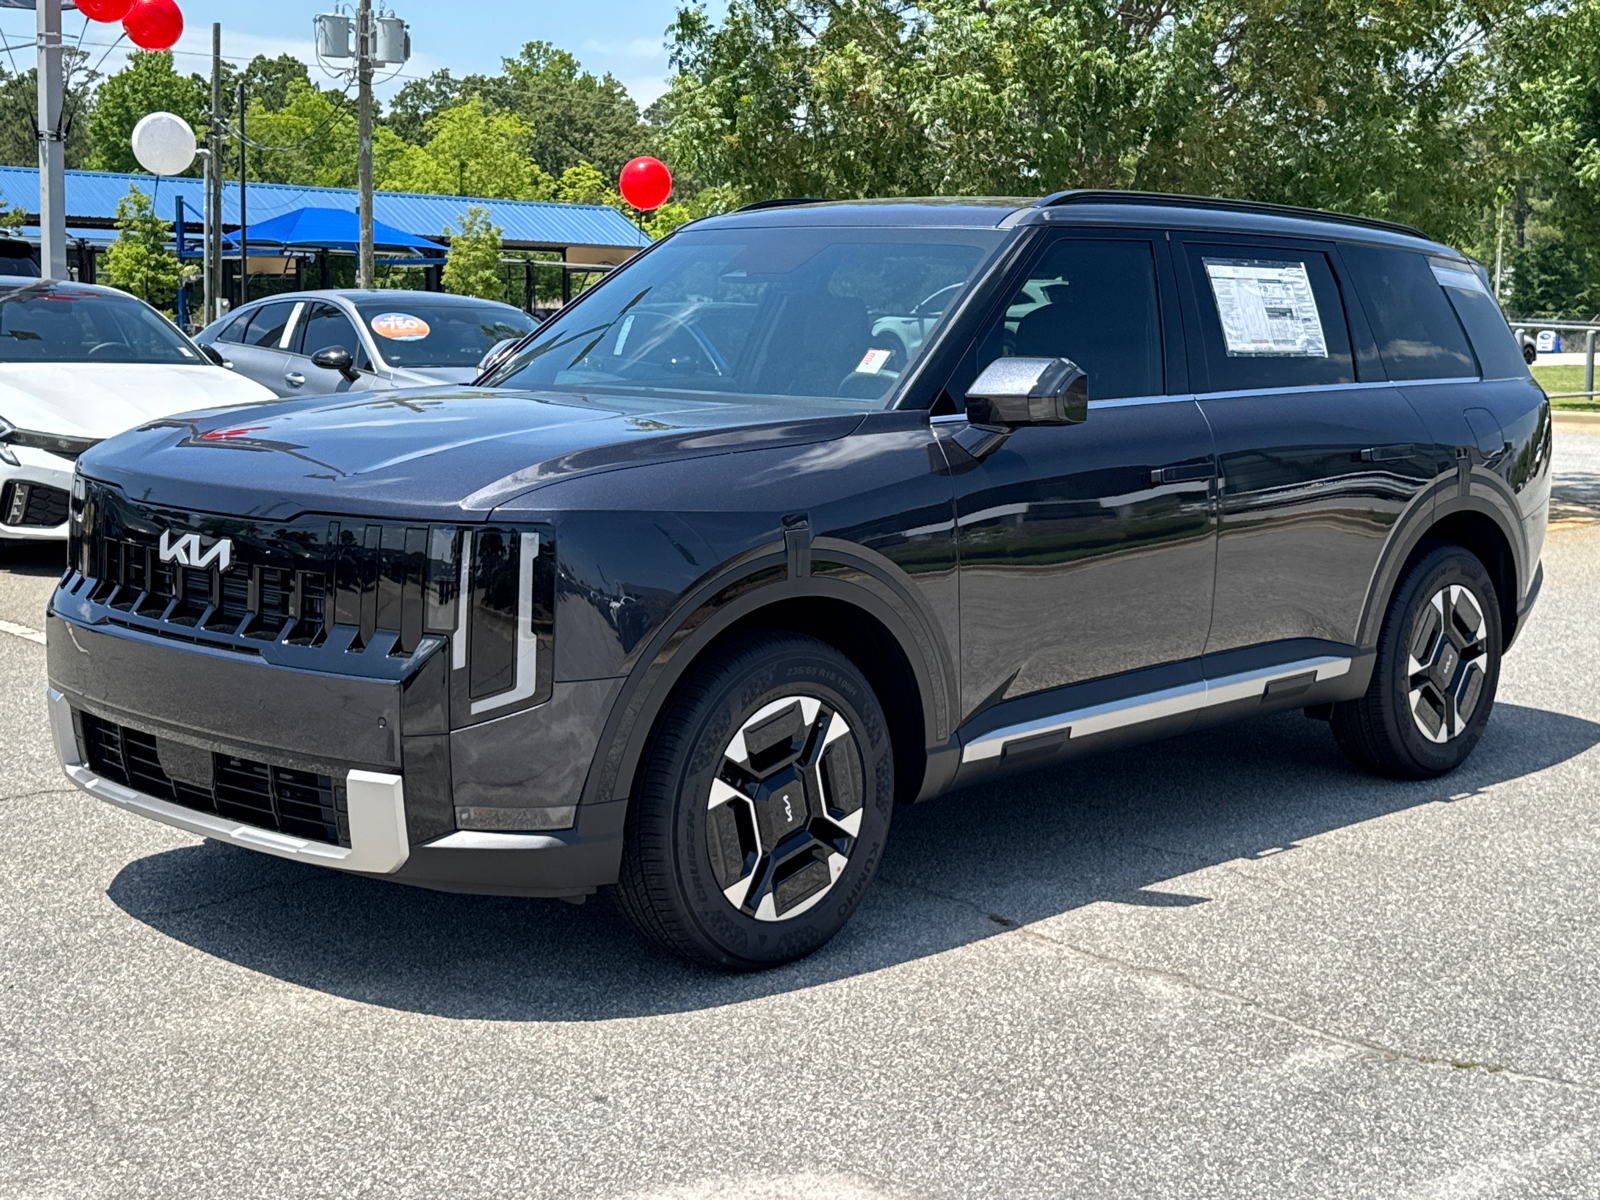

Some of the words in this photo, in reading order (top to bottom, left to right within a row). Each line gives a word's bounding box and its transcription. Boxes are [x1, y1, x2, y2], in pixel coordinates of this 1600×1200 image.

[159, 528, 232, 572] KIA
[786, 666, 818, 677] 235/65
[818, 668, 836, 681] R18
[686, 809, 708, 903] CRUGEN
[837, 841, 880, 917] KUMHO
